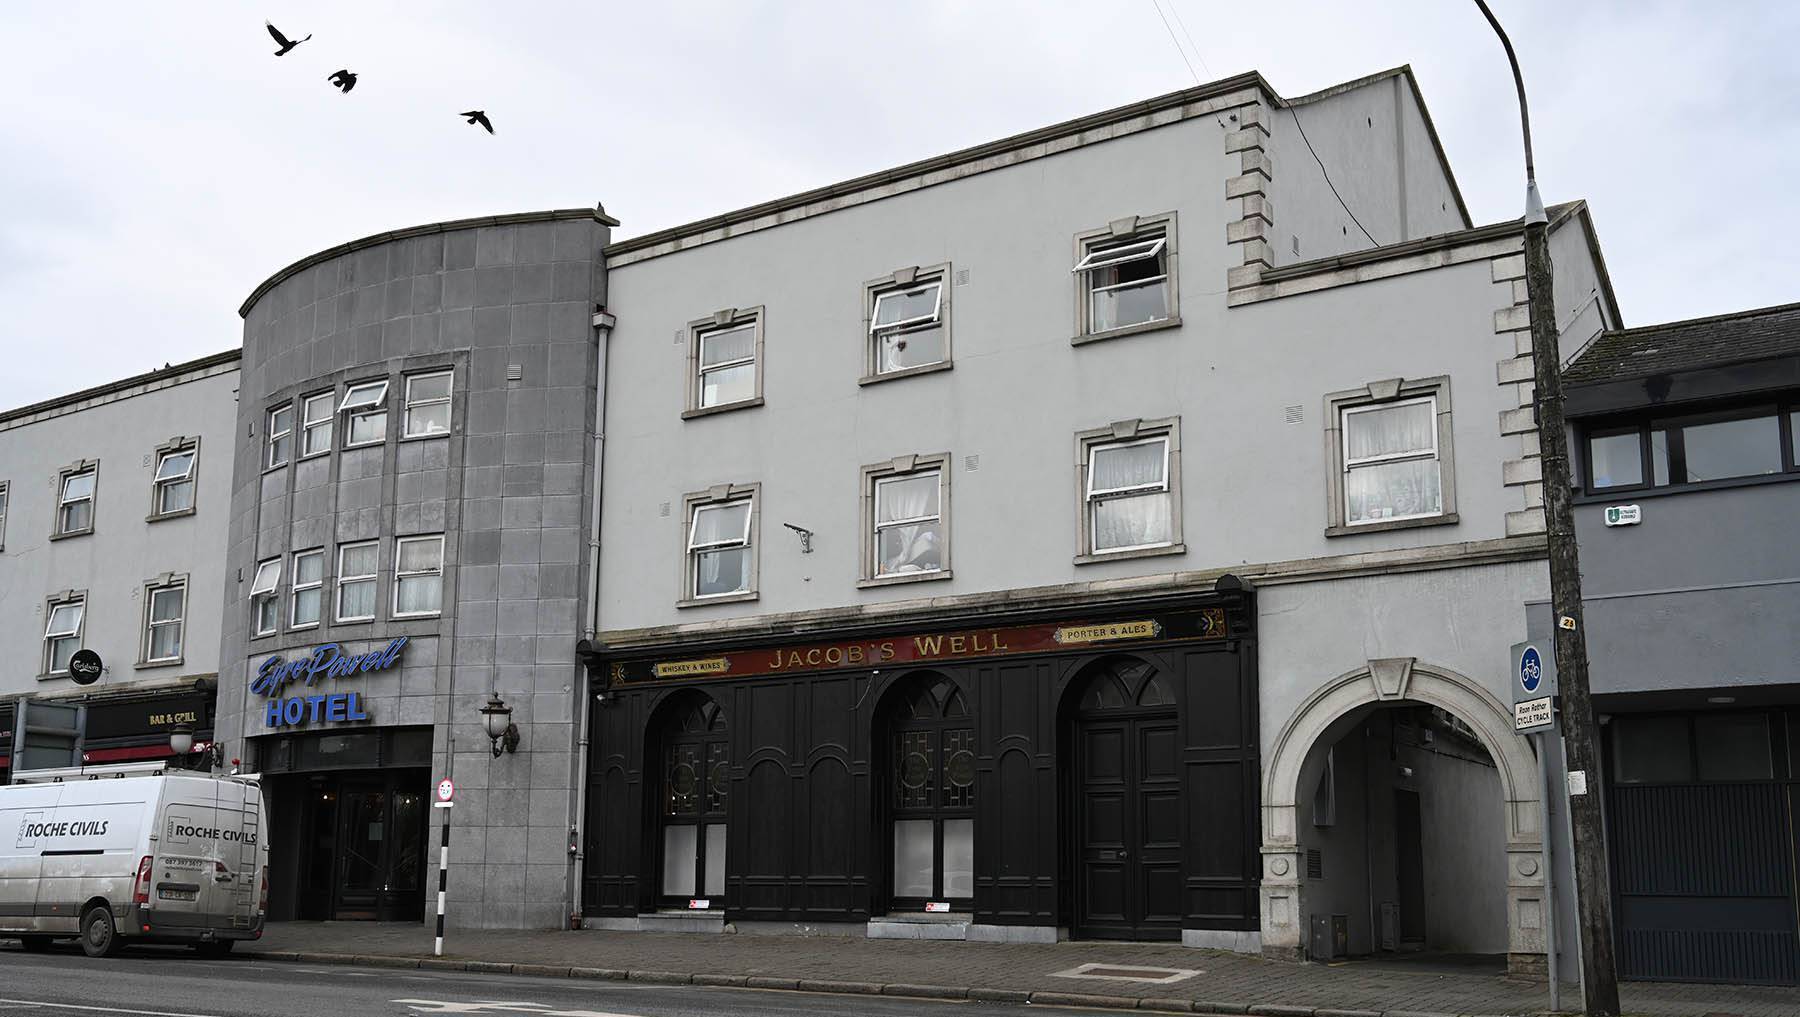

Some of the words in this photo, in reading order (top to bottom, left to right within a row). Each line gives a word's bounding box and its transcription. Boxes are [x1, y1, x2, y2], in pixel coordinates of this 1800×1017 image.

[1067, 629, 1106, 639] PORTER
[1110, 627, 1117, 635] &
[1121, 625, 1147, 634] ALES
[769, 642, 895, 669] JACOB'S
[913, 633, 1009, 656] WELL
[249, 655, 308, 697] Eyre
[304, 635, 406, 687] Powell
[661, 664, 691, 673] WHISKEY
[699, 662, 721, 671] WINES
[266, 692, 366, 727] HOTEL
[149, 714, 165, 725] BAR
[166, 713, 174, 724] &
[1517, 715, 1533, 726] CYCLE
[1533, 712, 1550, 722] TRACK
[25, 822, 69, 838] ROCHE
[69, 820, 109, 837] CIVILS
[175, 825, 221, 839] ROCHE
[222, 829, 257, 843] CIVILS
